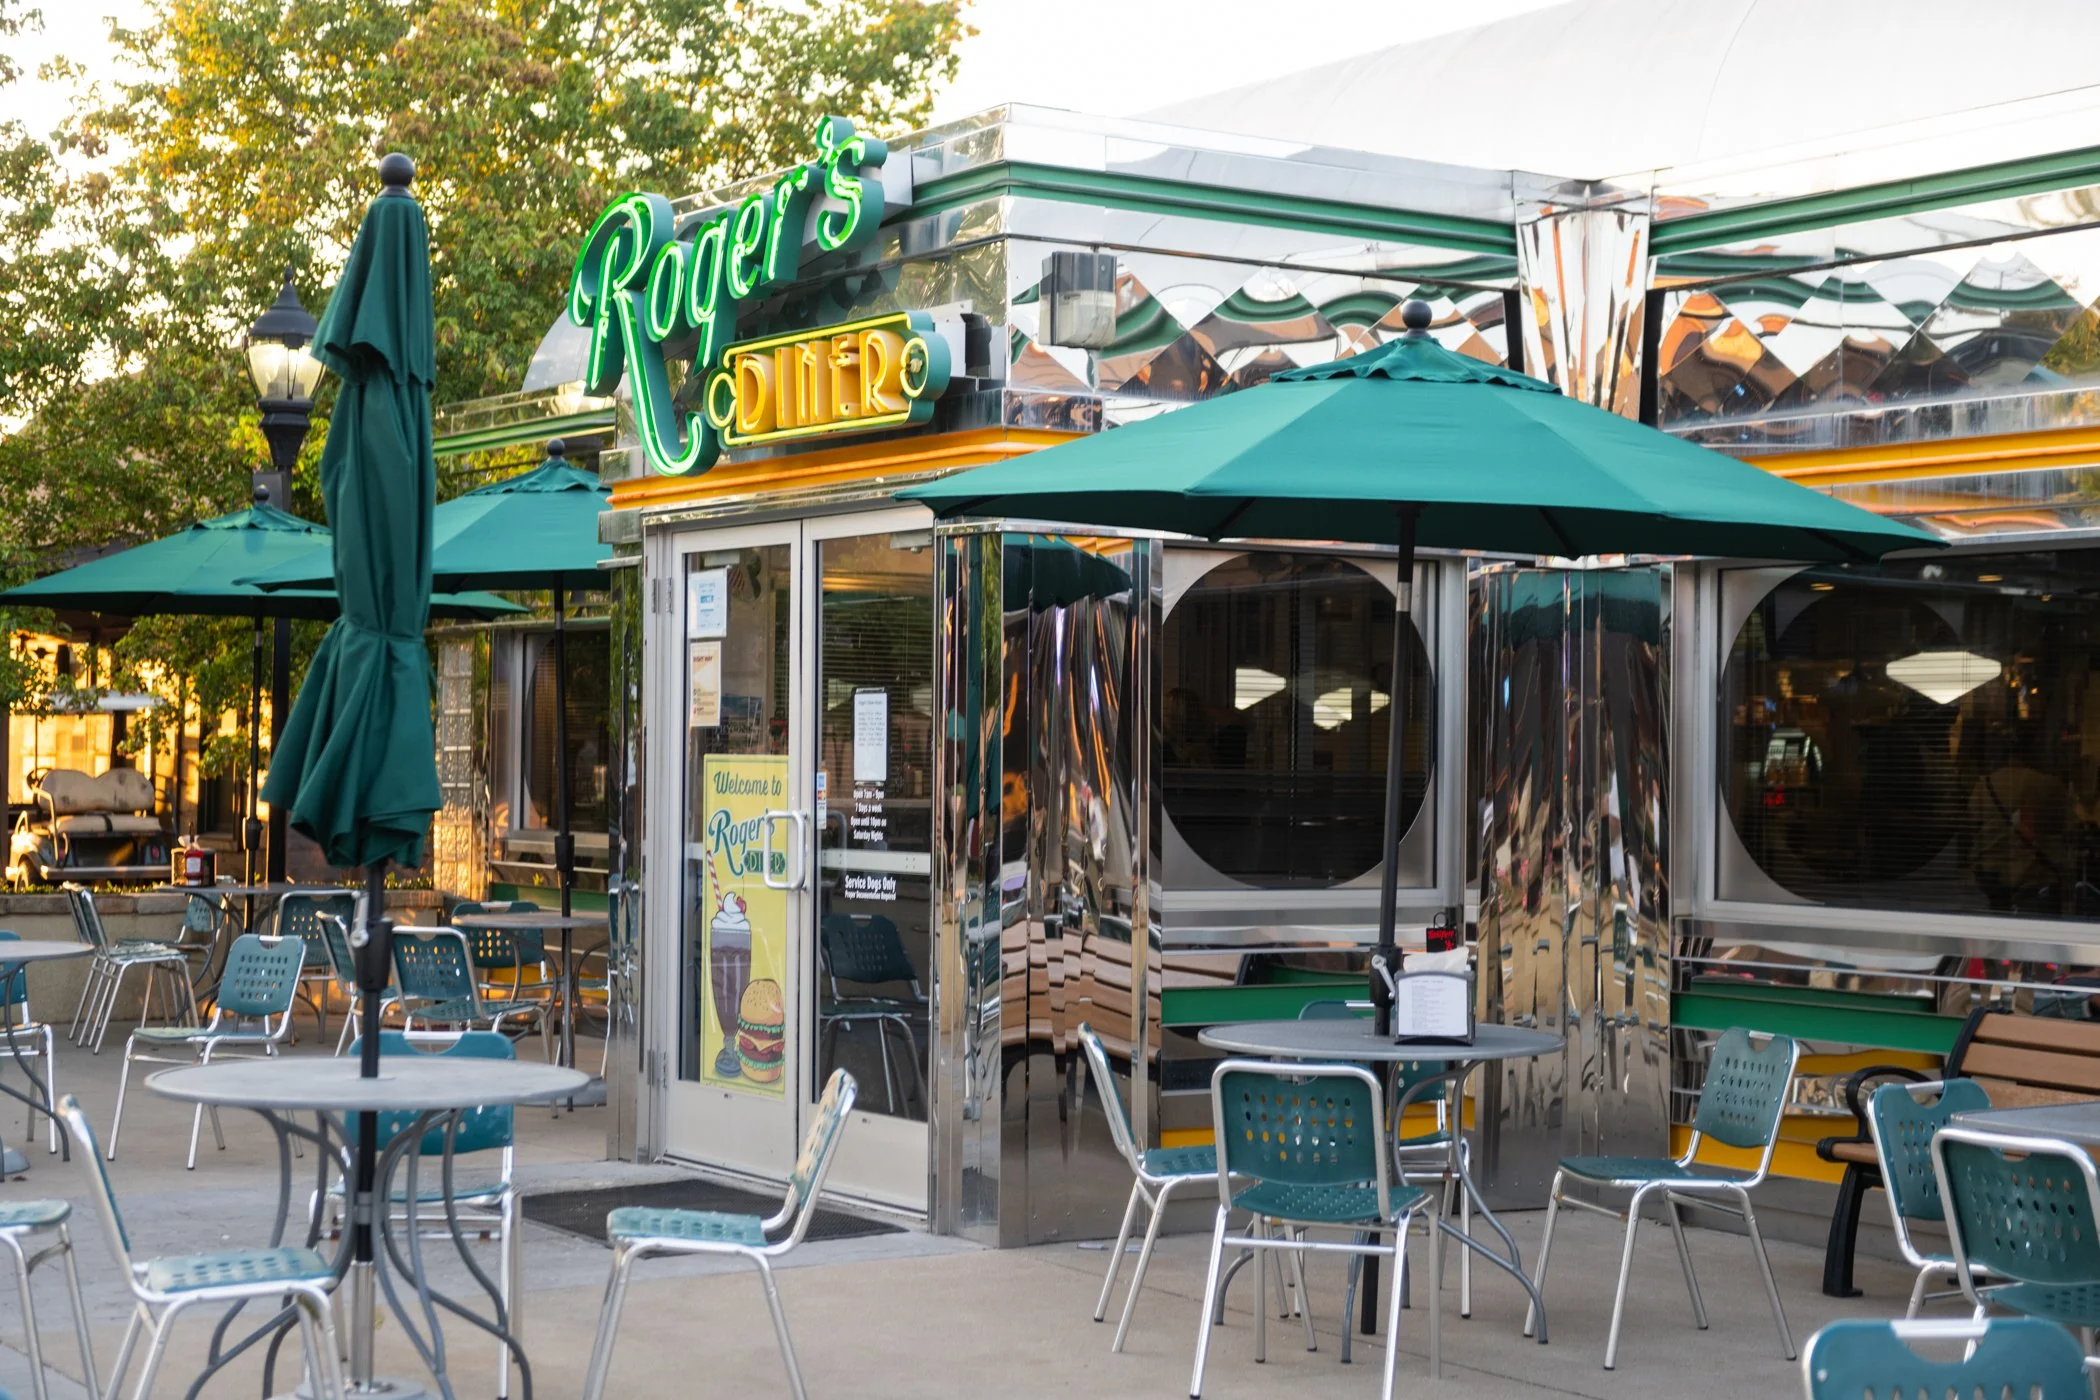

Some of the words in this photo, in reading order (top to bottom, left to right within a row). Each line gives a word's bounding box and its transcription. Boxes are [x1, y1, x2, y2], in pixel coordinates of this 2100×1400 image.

[569, 115, 887, 476] Roger's
[735, 329, 912, 434] DINER
[713, 771, 769, 796] Welcome
[771, 775, 782, 796] to
[750, 851, 780, 872] DIR
[845, 874, 866, 889] Service
[867, 875, 881, 893] Dogs
[882, 876, 896, 893] Only
